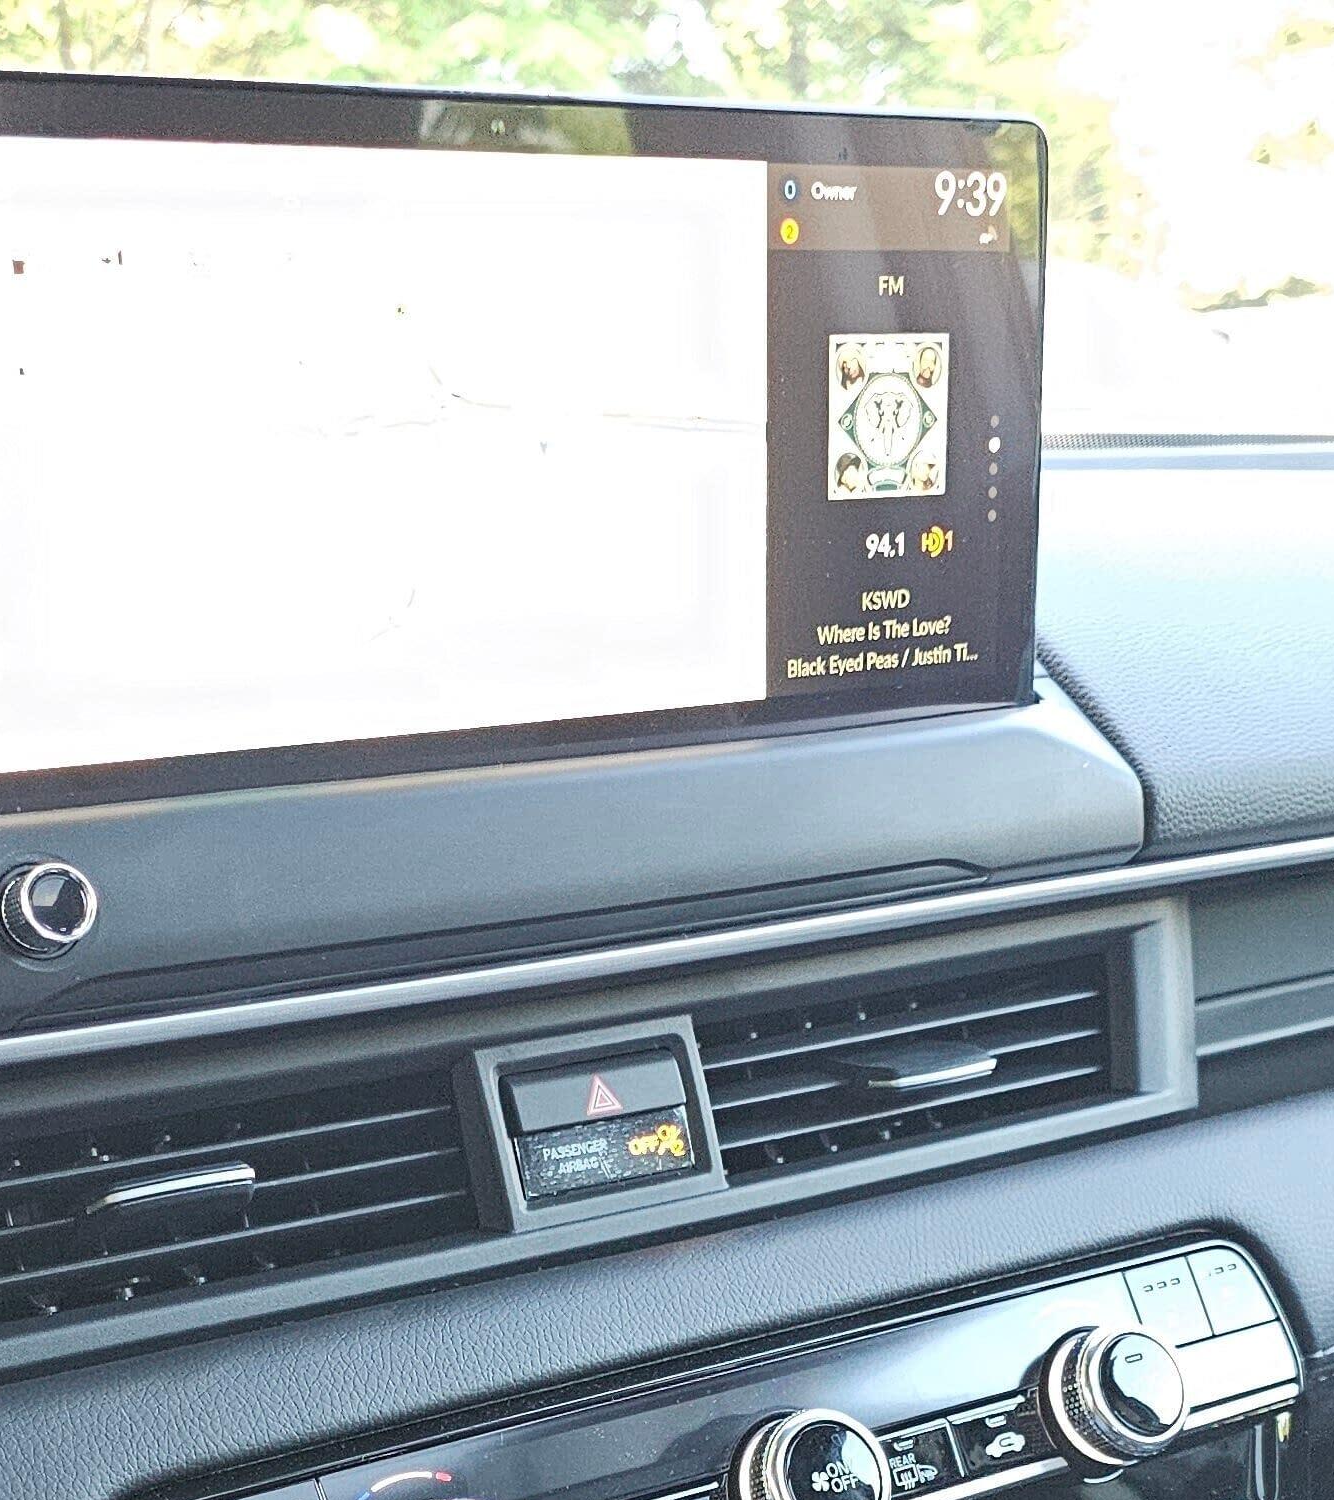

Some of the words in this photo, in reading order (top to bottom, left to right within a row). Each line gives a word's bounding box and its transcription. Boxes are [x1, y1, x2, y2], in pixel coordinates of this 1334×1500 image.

[811, 181, 857, 201] Owner
[934, 170, 1007, 217] 9:39
[878, 275, 904, 296] FM
[866, 532, 905, 559] 94.1
[861, 588, 911, 611] KSWD
[817, 623, 865, 646] Where
[868, 622, 881, 642] Is
[883, 619, 910, 640] The
[912, 615, 952, 637] Love?
[787, 657, 826, 679] Black
[829, 652, 864, 677] Eyed
[866, 650, 899, 672] Peas
[901, 648, 910, 668] /
[911, 644, 952, 667] Justin
[543, 1138, 608, 1161] PASSENGER
[557, 1156, 600, 1175] AIRBAG
[889, 1453, 916, 1469] REAR
[831, 1473, 859, 1493] OFF
